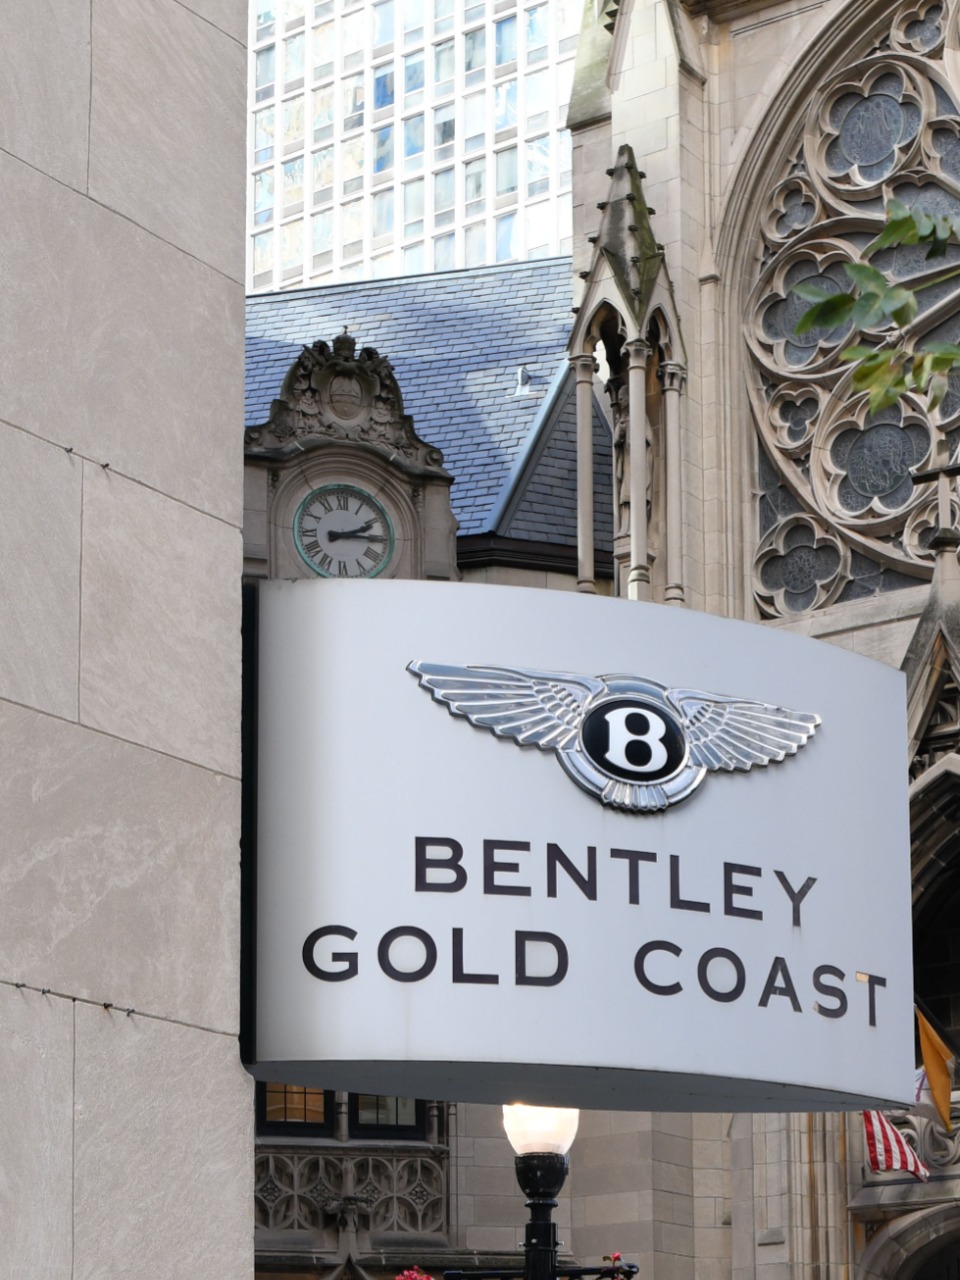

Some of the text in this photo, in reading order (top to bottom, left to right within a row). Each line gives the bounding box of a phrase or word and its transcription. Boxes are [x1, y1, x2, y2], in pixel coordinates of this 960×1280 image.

[336, 495, 349, 511] XII
[354, 501, 365, 516] I
[604, 706, 668, 773] B
[414, 836, 818, 927] BENTLEY
[301, 924, 887, 1027] GOLD COAST
